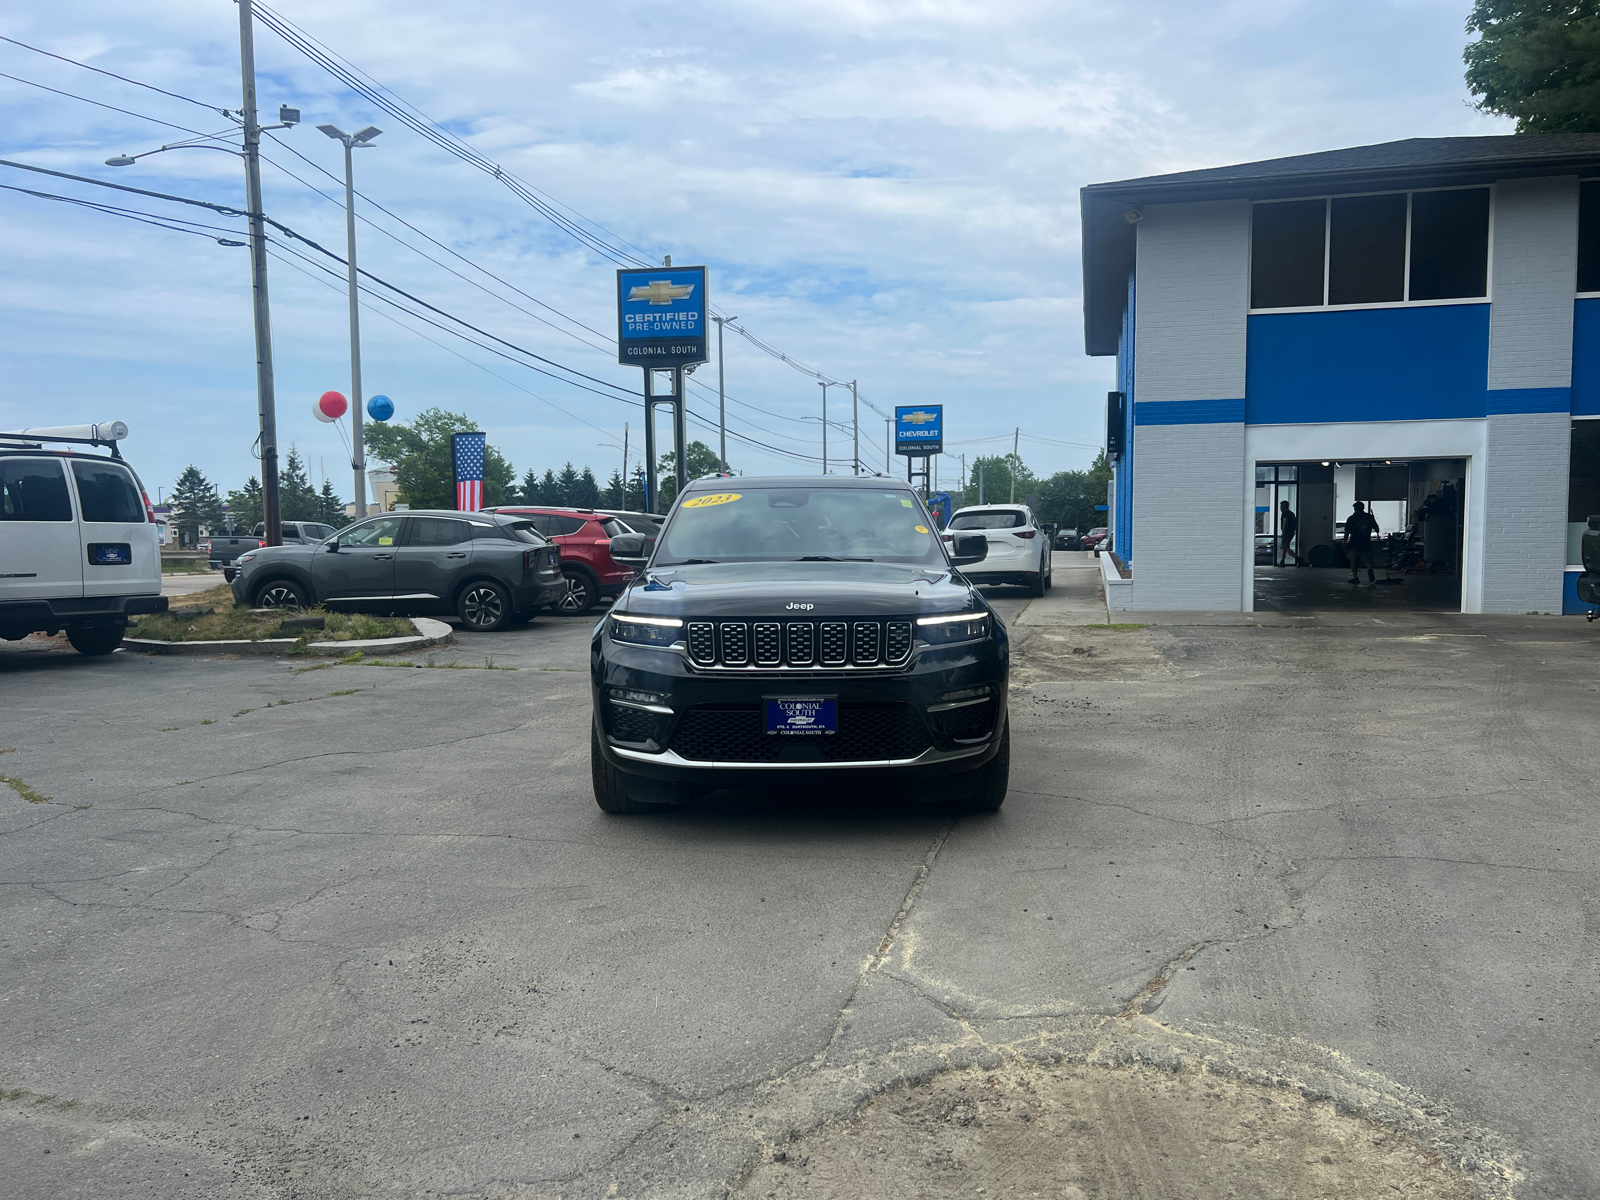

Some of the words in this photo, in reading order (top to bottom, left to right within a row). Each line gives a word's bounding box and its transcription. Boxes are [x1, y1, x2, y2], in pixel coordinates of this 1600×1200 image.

[625, 311, 698, 322] CERTIFIED
[629, 321, 695, 331] PRE-OWNED
[628, 346, 666, 355] COLONIAL
[671, 345, 697, 354] SOUTH
[690, 494, 733, 507] 2023
[785, 602, 814, 611] Jeep
